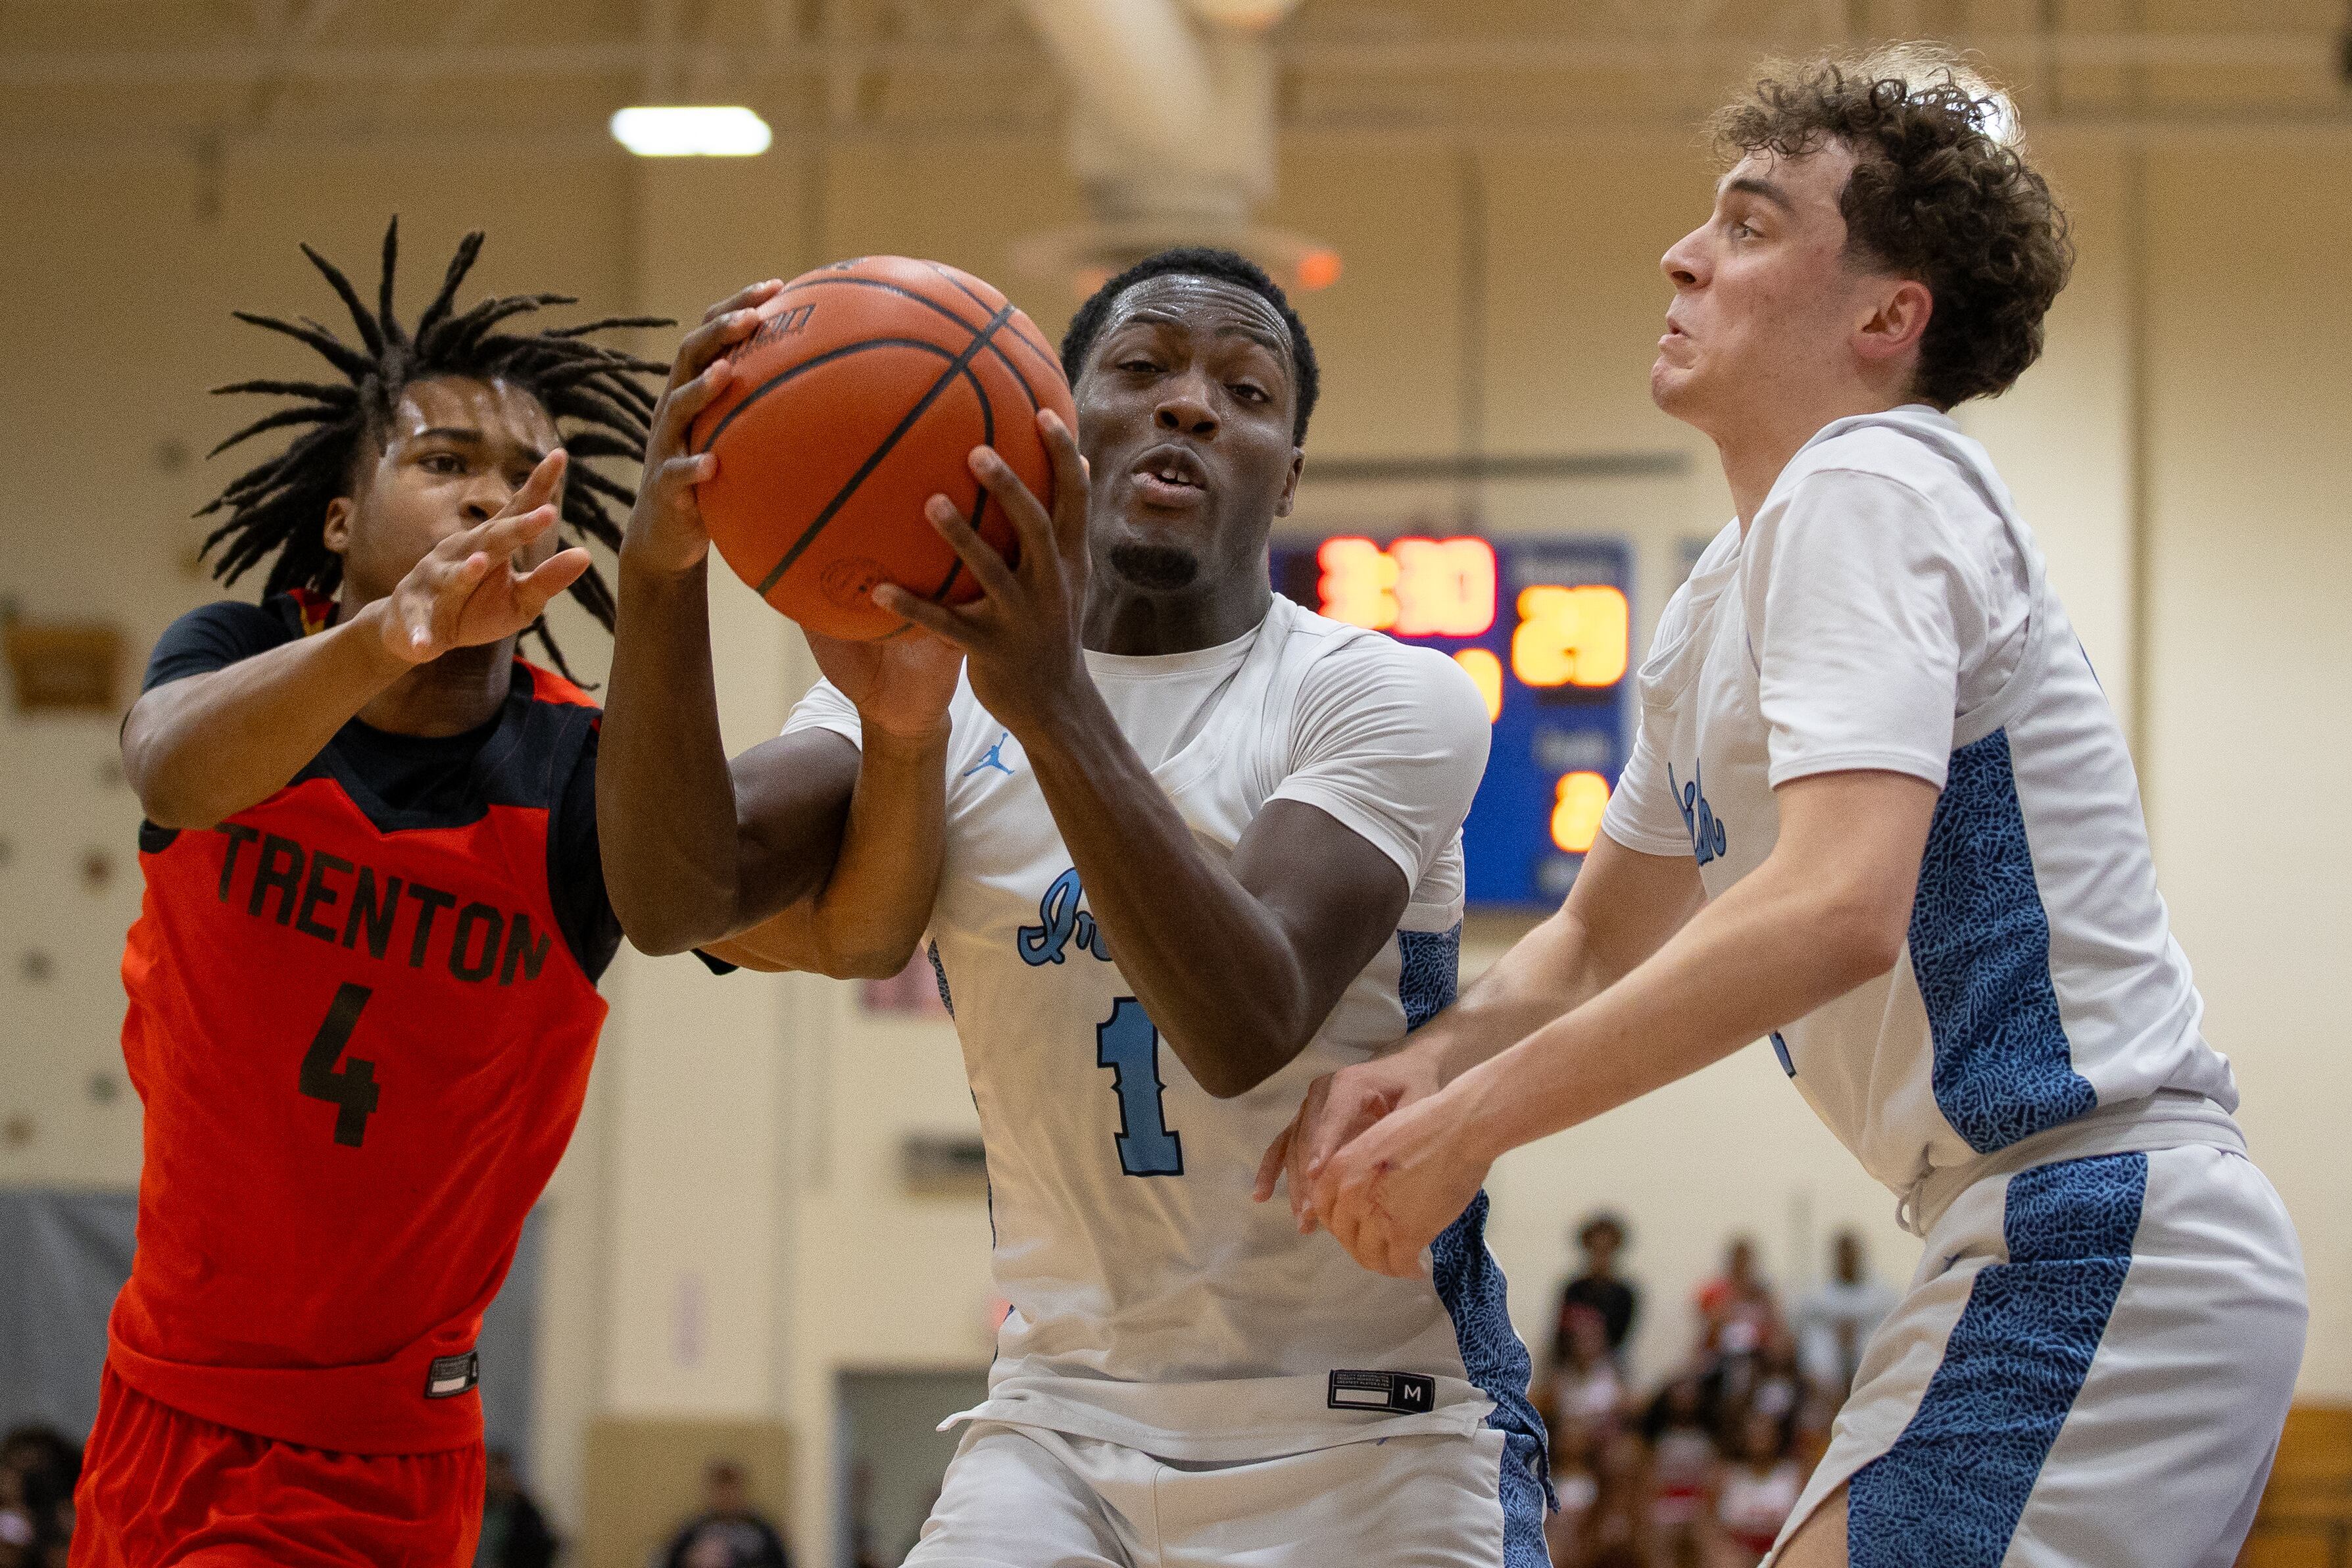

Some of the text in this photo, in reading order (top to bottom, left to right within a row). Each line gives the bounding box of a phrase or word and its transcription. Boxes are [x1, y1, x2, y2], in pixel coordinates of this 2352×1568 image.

[214, 822, 551, 987] TRENTON
[299, 981, 380, 1148] 4
[1096, 996, 1184, 1176] 1
[1404, 1384, 1421, 1402] M
